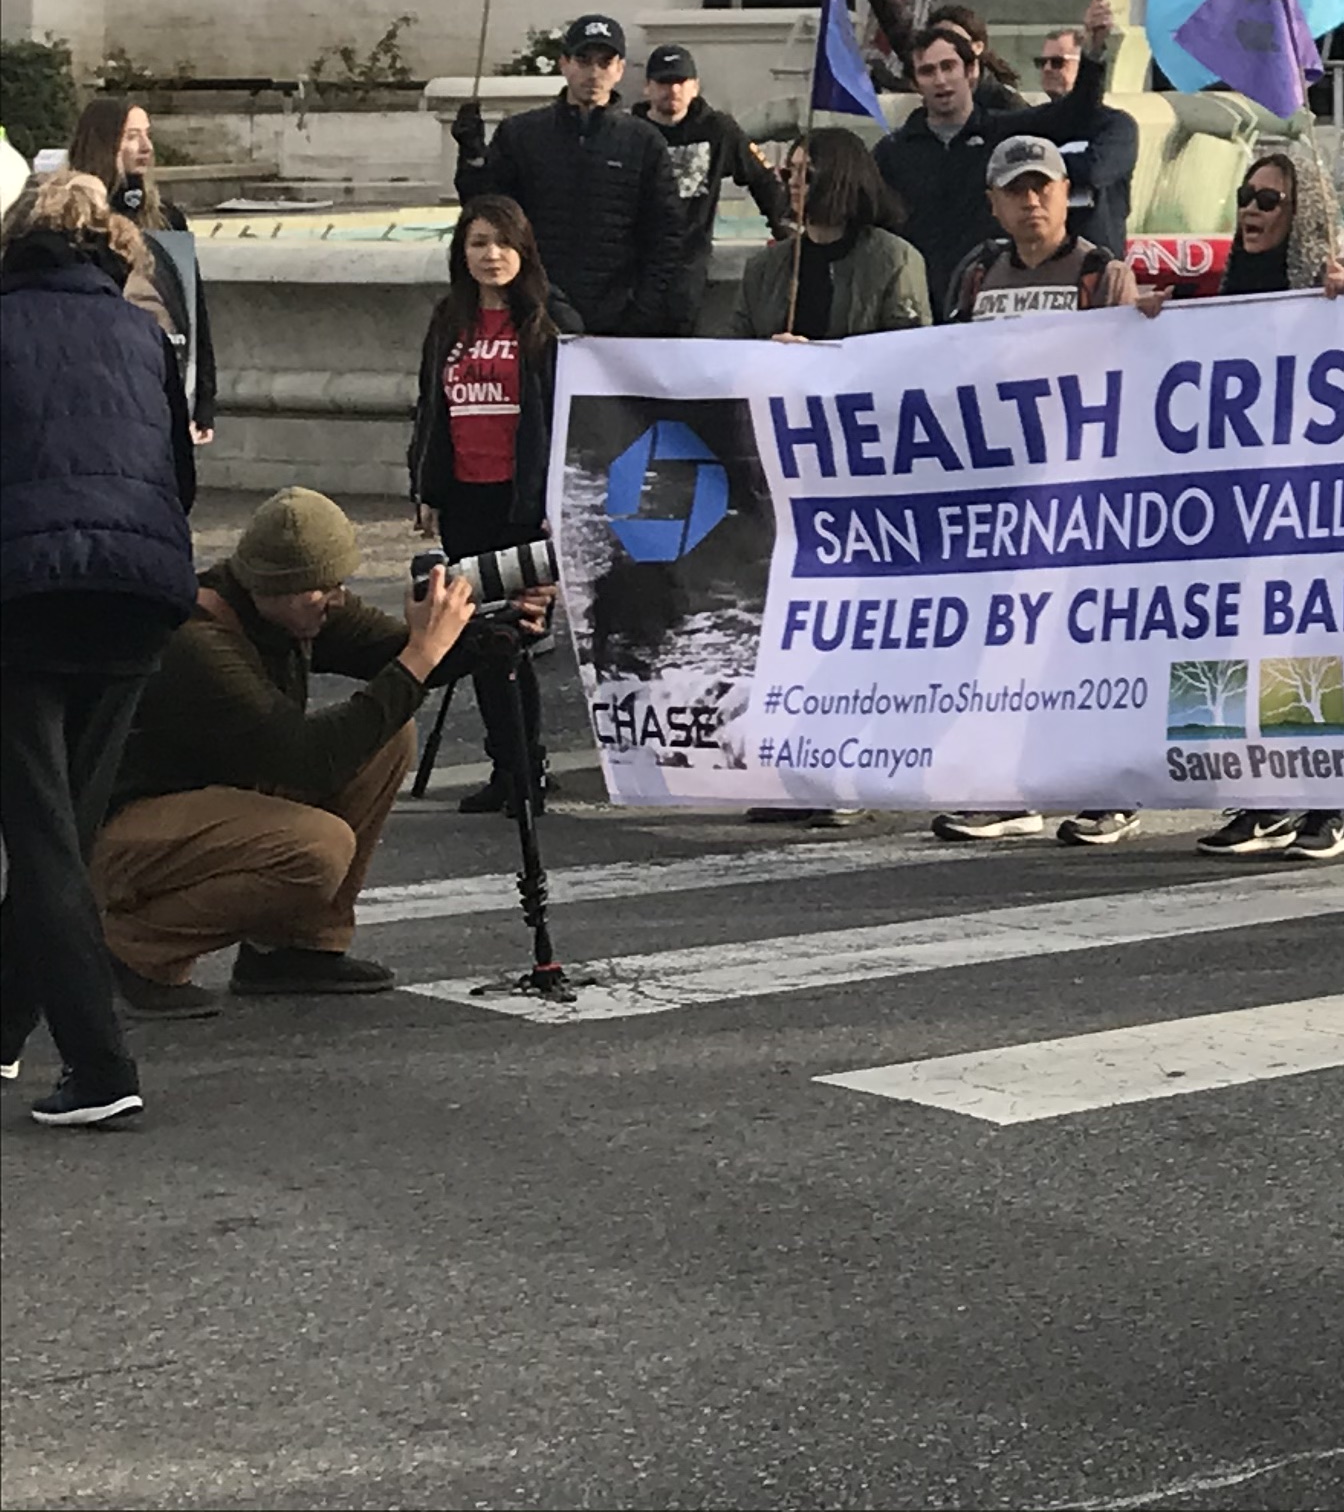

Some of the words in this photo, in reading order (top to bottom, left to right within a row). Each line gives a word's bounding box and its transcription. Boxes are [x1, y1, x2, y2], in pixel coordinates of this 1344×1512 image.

[769, 370, 1123, 478] HEALTH
[813, 507, 921, 565] SAN
[938, 486, 1214, 560] FERNANDO
[781, 596, 968, 652] FUELED
[984, 591, 1053, 646] BY
[1067, 581, 1241, 644] CHASE
[592, 694, 720, 749] CHASE
[764, 677, 1148, 716] #CountdownToShutdown2020
[758, 735, 933, 777] #AlisoCanyon
[1166, 746, 1242, 781] Save
